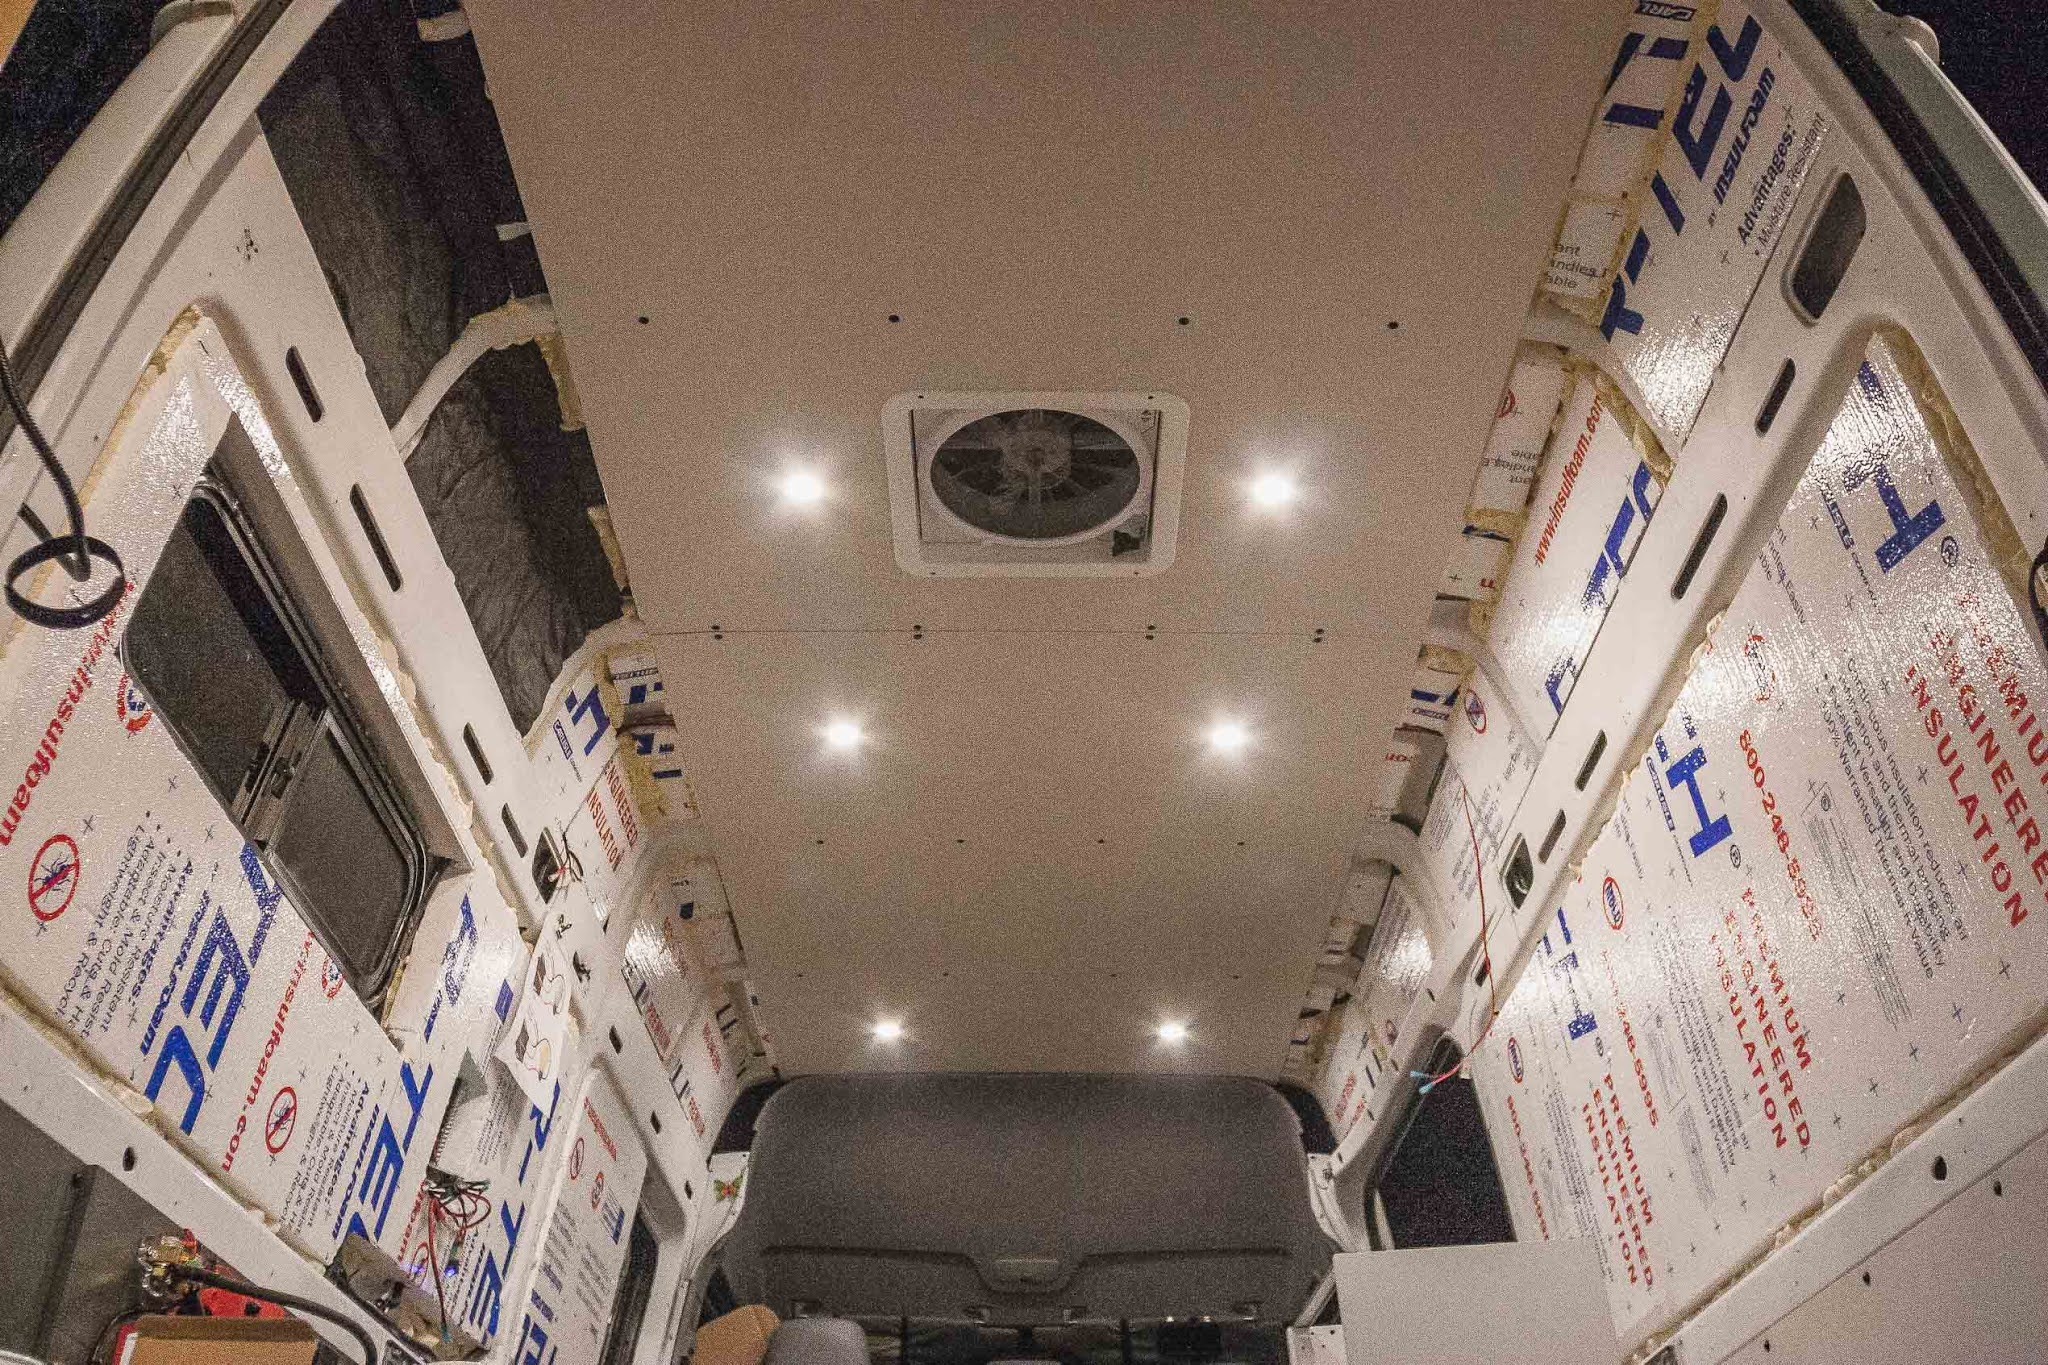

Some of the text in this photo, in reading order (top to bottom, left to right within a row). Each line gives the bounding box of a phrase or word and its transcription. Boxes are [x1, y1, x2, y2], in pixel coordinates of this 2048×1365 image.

[1735, 121, 1797, 245] Advantages:
[1758, 111, 1824, 247] Moisture Resistant
[552, 719, 574, 759] CARLISLE
[1957, 592, 2048, 785] PREMIU
[1836, 749, 1878, 834] Warranted
[1871, 838, 1908, 908] Thermal
[1872, 759, 1892, 789] and
[1886, 794, 1922, 861] thermal
[1883, 753, 1927, 838] insulation
[1920, 840, 1958, 913] reduces
[1905, 664, 2028, 928] INSULATION
[1930, 630, 2048, 905] ENGINEERE
[85, 930, 98, 948] &
[92, 823, 145, 929] Lightweight
[108, 834, 156, 935] Adaptable:
[125, 857, 193, 1008] Advantages:
[129, 907, 140, 923] &
[137, 850, 165, 904] Insect
[99, 944, 141, 1032] Resistant
[107, 927, 131, 975] Mold
[1740, 887, 1815, 1071] PREMIUM
[1707, 931, 1788, 1150] INSULATION
[1722, 909, 1814, 1150] ENGINEERED
[312, 1145, 329, 1183] Mold
[323, 1081, 370, 1204] Advantages:
[1580, 1102, 1639, 1286] INSULATION
[1591, 1087, 1655, 1287] ENGINEERED
[1602, 1073, 1654, 1227] PREMIUM
